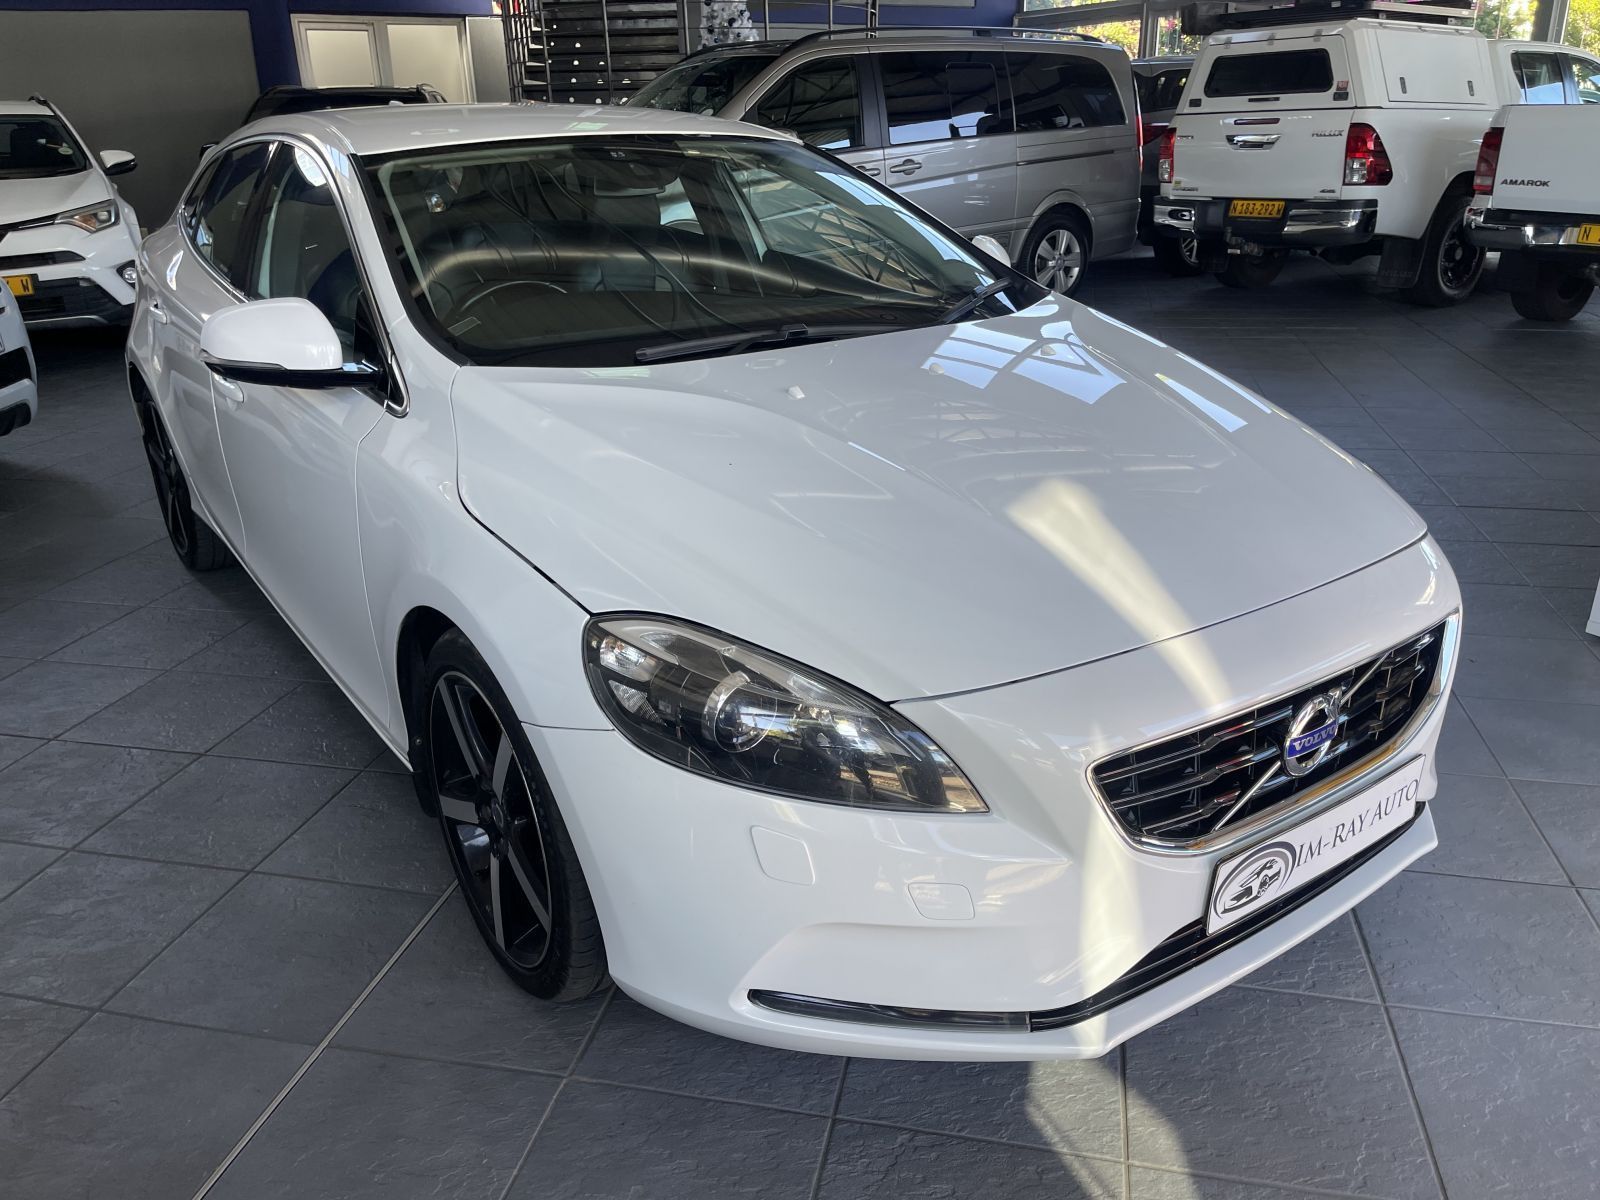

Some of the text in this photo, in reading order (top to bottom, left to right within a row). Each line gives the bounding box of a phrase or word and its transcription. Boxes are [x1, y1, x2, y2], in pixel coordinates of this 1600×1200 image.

[1500, 178, 1551, 188] AMAROK
[1232, 202, 1239, 214] N
[1581, 226, 1593, 241] N
[20, 278, 30, 293] W
[1293, 724, 1337, 751] VOLVO
[1370, 778, 1419, 826] AUTO
